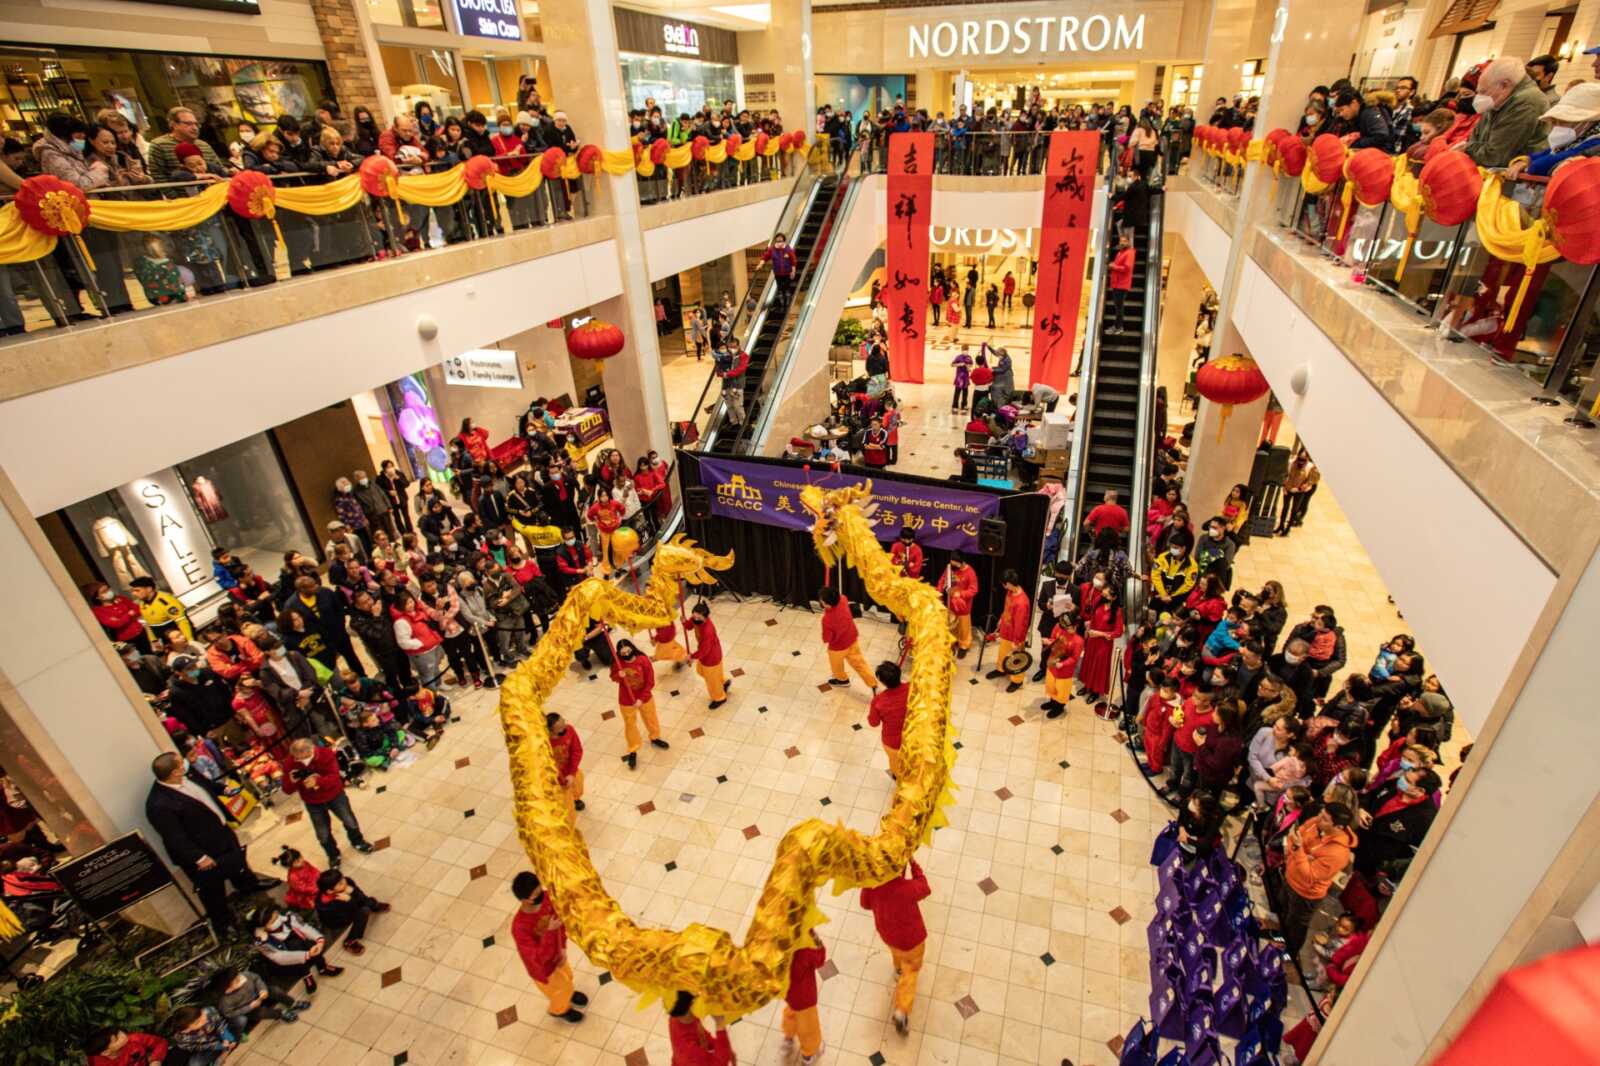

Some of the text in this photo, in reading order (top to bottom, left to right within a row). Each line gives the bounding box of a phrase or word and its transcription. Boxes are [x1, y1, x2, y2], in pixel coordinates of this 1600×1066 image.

[908, 14, 1145, 58] NORDSTROM
[718, 497, 763, 511] CCACC
[901, 496, 932, 508] Service
[142, 484, 207, 585] SALE
